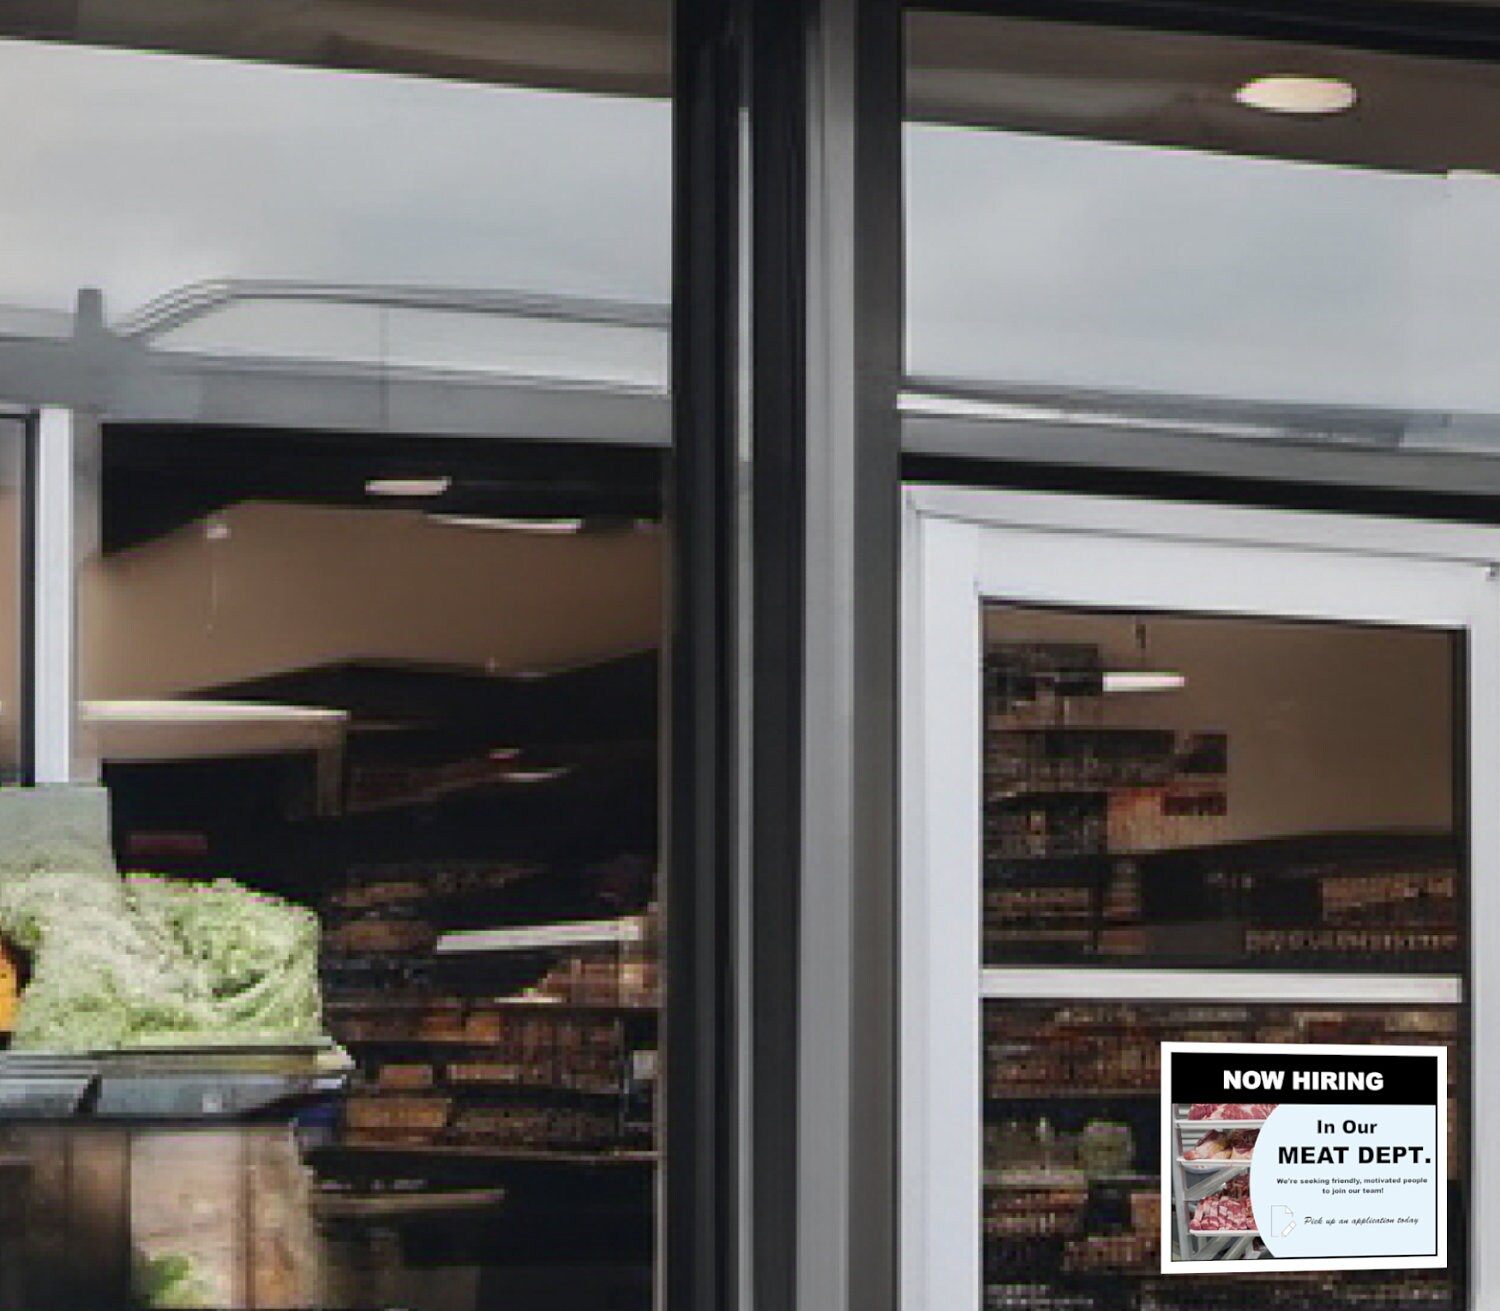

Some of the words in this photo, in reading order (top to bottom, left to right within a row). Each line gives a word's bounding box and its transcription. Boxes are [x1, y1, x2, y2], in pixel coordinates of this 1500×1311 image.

[1224, 1070, 1285, 1090] NOW
[1293, 1071, 1384, 1091] HIRING
[1316, 1119, 1335, 1134] In
[1342, 1119, 1378, 1135] Our
[1278, 1146, 1350, 1164] MEAT
[1358, 1146, 1432, 1164] DEPT.
[1300, 1178, 1330, 1186] seeking
[1331, 1178, 1362, 1186] friendly,
[1364, 1177, 1401, 1185] motivated
[1403, 1177, 1428, 1185] people
[1332, 1187, 1346, 1196] join
[1303, 1216, 1323, 1225] Pick
[1325, 1218, 1336, 1226] up
[1351, 1216, 1395, 1226] application
[1397, 1216, 1419, 1225] today
